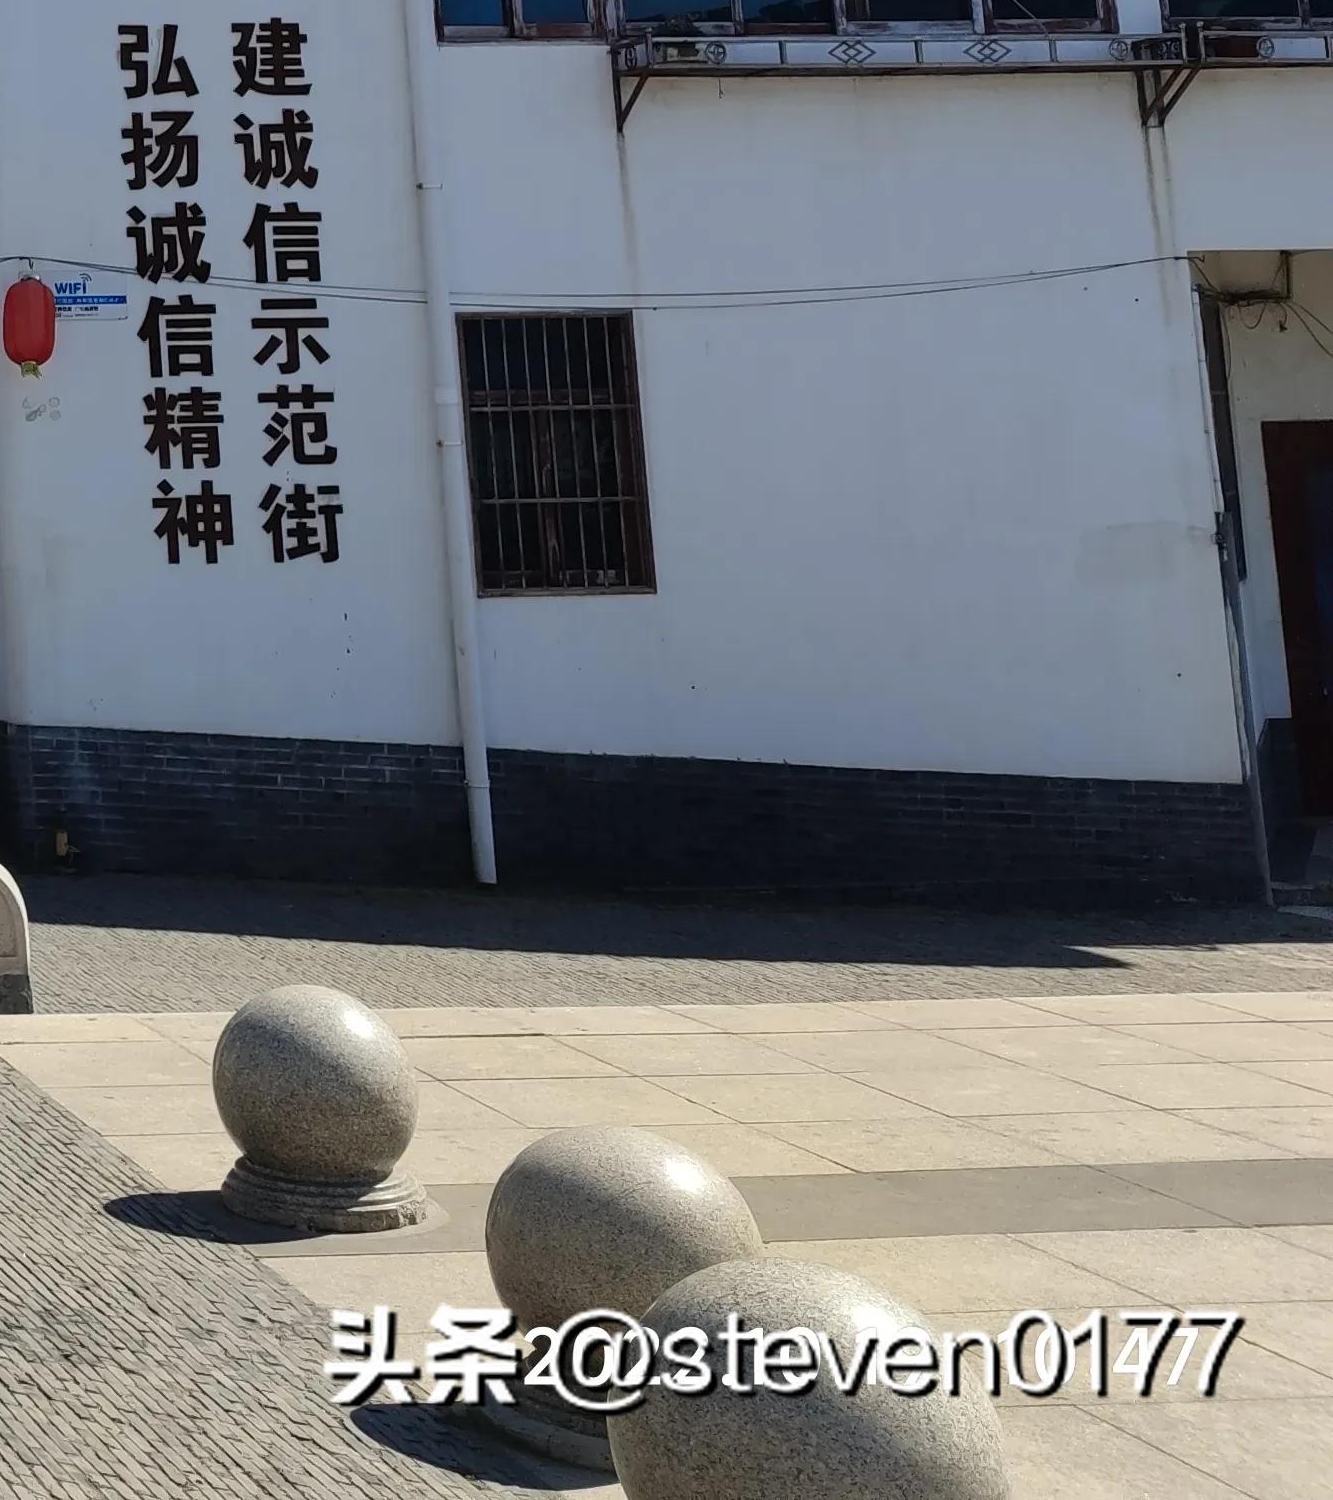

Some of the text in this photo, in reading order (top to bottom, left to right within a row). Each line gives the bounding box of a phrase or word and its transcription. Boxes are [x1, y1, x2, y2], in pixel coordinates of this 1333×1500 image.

[117, 24, 234, 564] 弘扬诚信精神
[231, 17, 344, 564] 建诚信示范街
